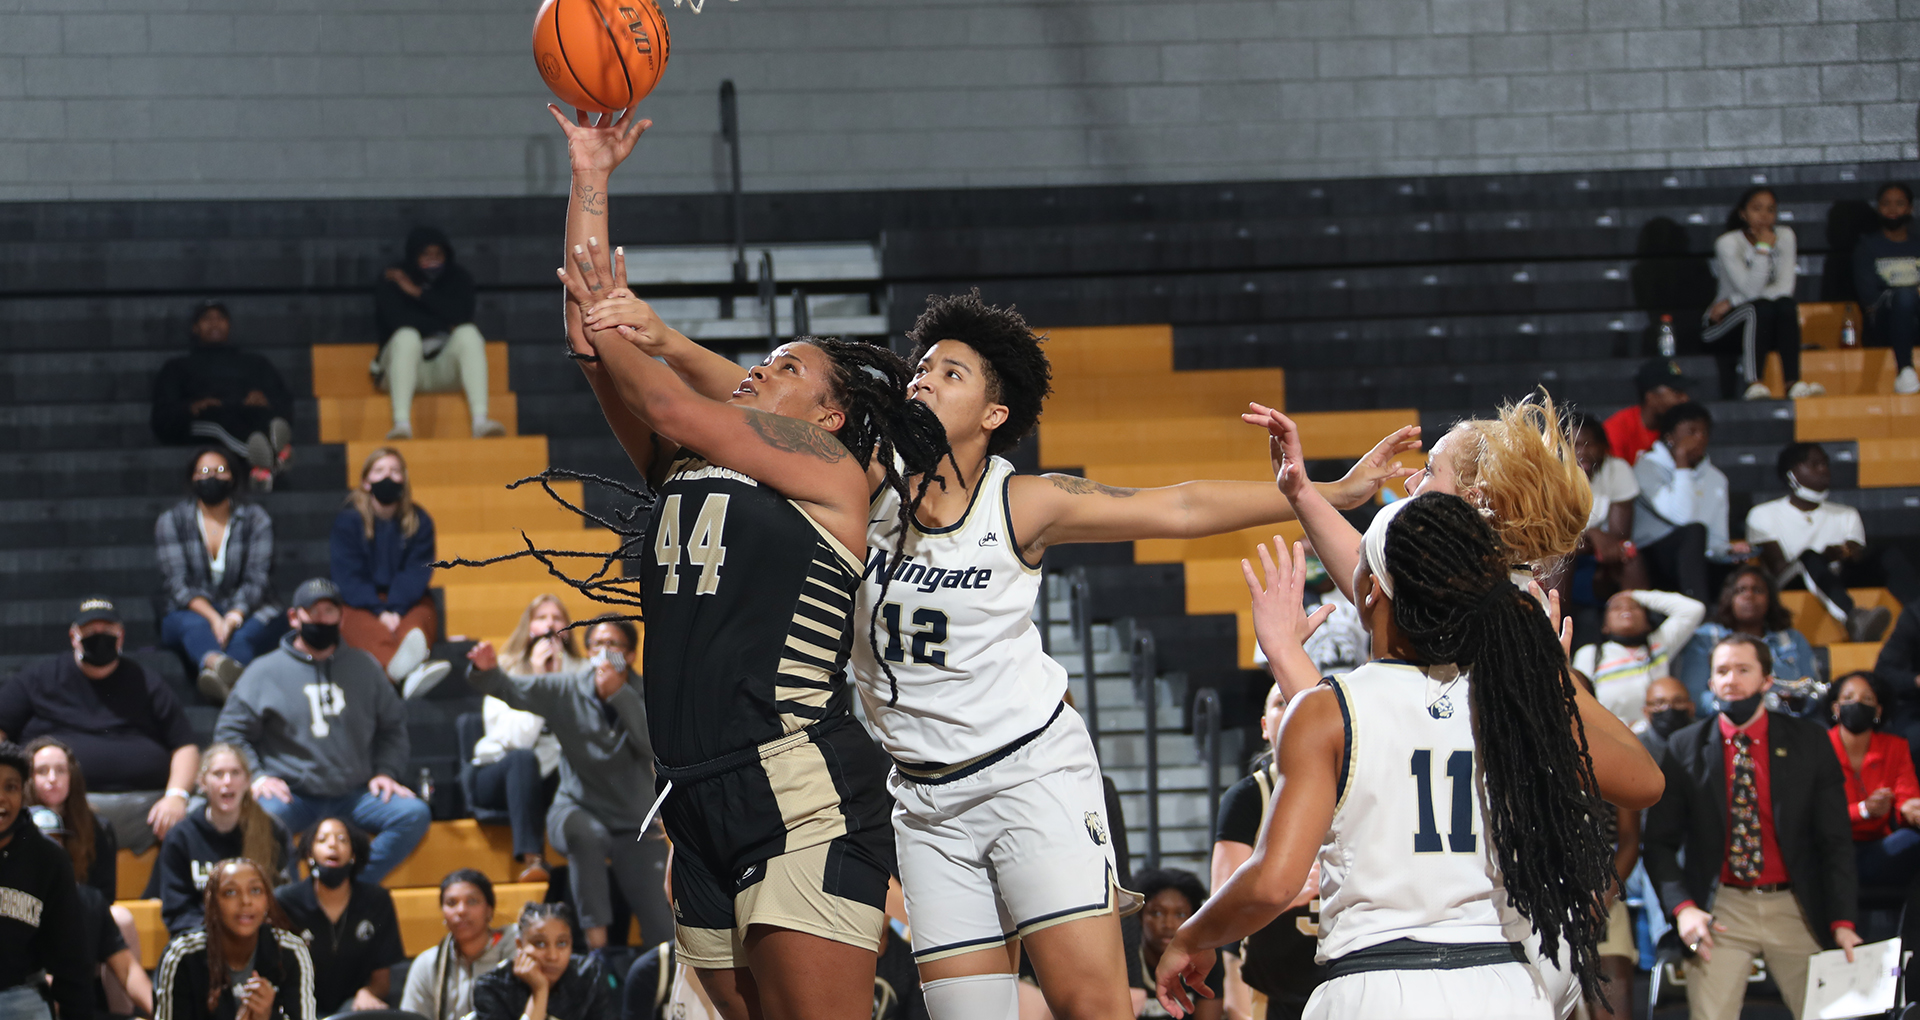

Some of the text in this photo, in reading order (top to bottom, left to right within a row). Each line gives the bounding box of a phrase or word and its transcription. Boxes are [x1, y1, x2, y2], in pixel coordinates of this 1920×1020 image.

[618, 7, 652, 55] EVO
[654, 493, 731, 596] 44
[861, 546, 993, 593] Wingate
[880, 601, 951, 667] 12
[1408, 747, 1478, 855] 11
[0, 886, 43, 928] BROKE
